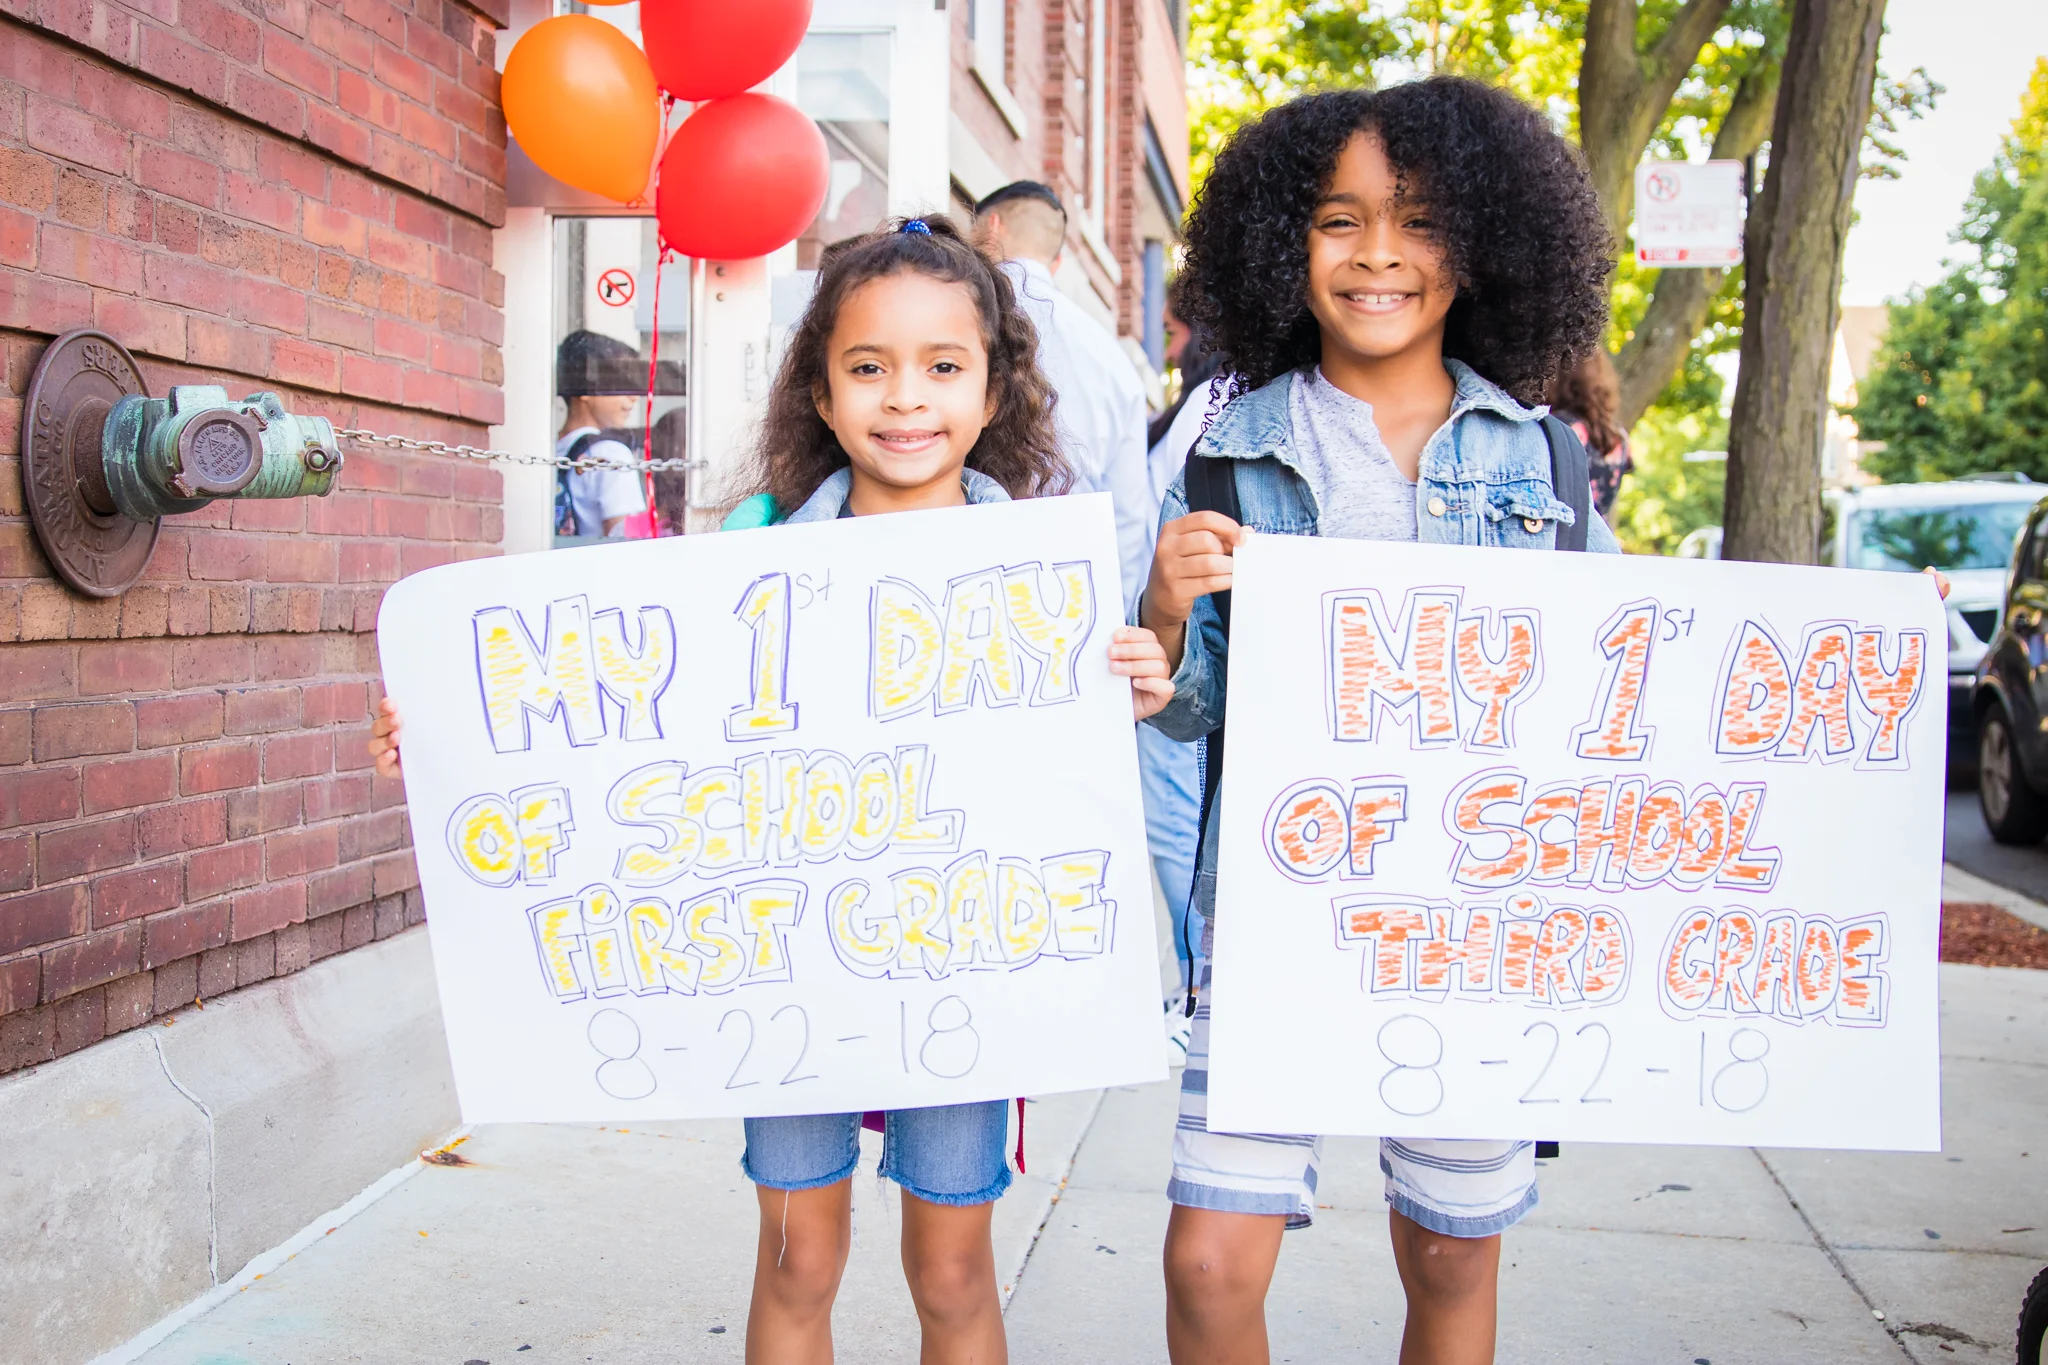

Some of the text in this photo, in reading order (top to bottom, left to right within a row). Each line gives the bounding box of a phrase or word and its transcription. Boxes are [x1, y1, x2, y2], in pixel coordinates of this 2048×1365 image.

[211, 443, 238, 468] CHICAGO
[215, 447, 246, 476] NEW YORK
[471, 594, 677, 754] MY
[867, 560, 1097, 722] DAY
[1321, 585, 1544, 756] MY
[1710, 613, 1928, 771] DAY
[446, 744, 965, 888] OF SCHOOL
[1262, 766, 1782, 894] OF SCHOOL
[826, 850, 1117, 981] GRADE
[1657, 904, 1891, 1029] GRADE
